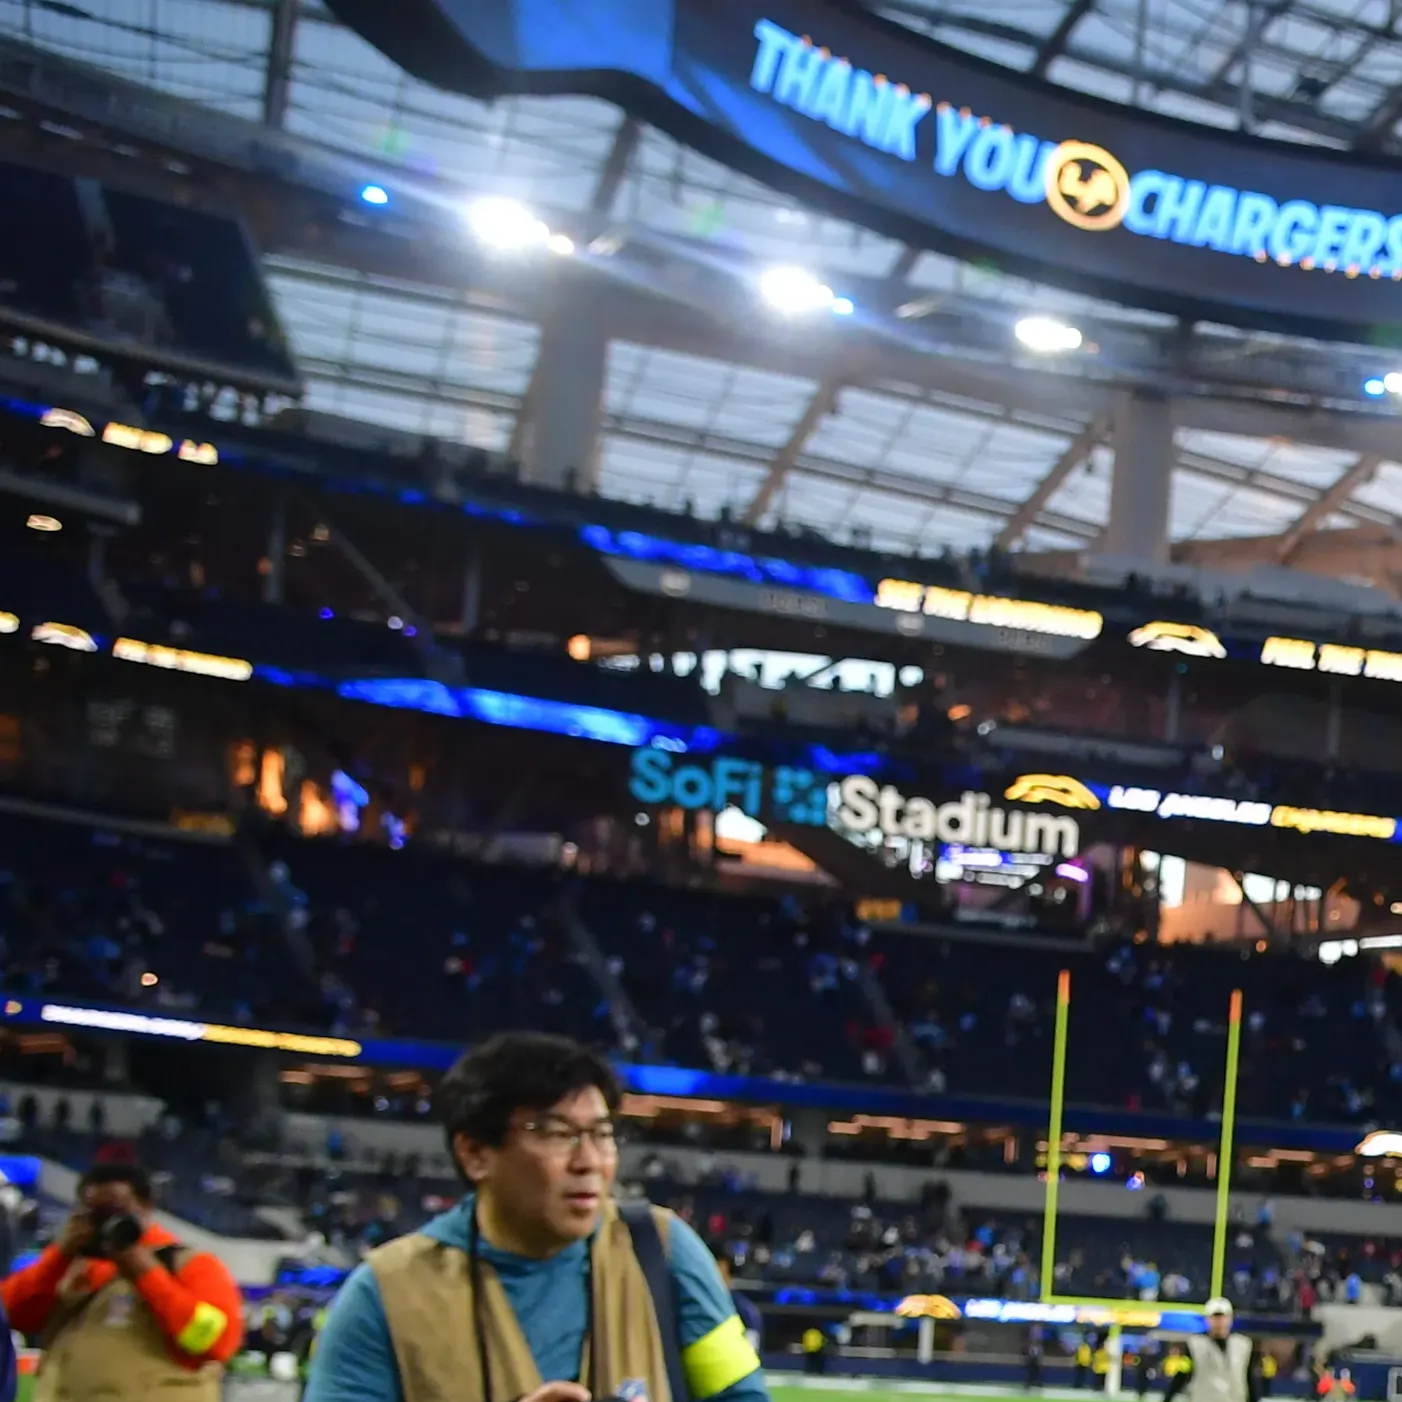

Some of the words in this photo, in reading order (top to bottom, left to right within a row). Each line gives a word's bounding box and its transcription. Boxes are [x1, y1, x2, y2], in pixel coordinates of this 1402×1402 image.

[754, 19, 932, 160] THANK
[936, 104, 1053, 203] YOU
[629, 746, 761, 816] SoFi
[840, 775, 1080, 857] Stadium
